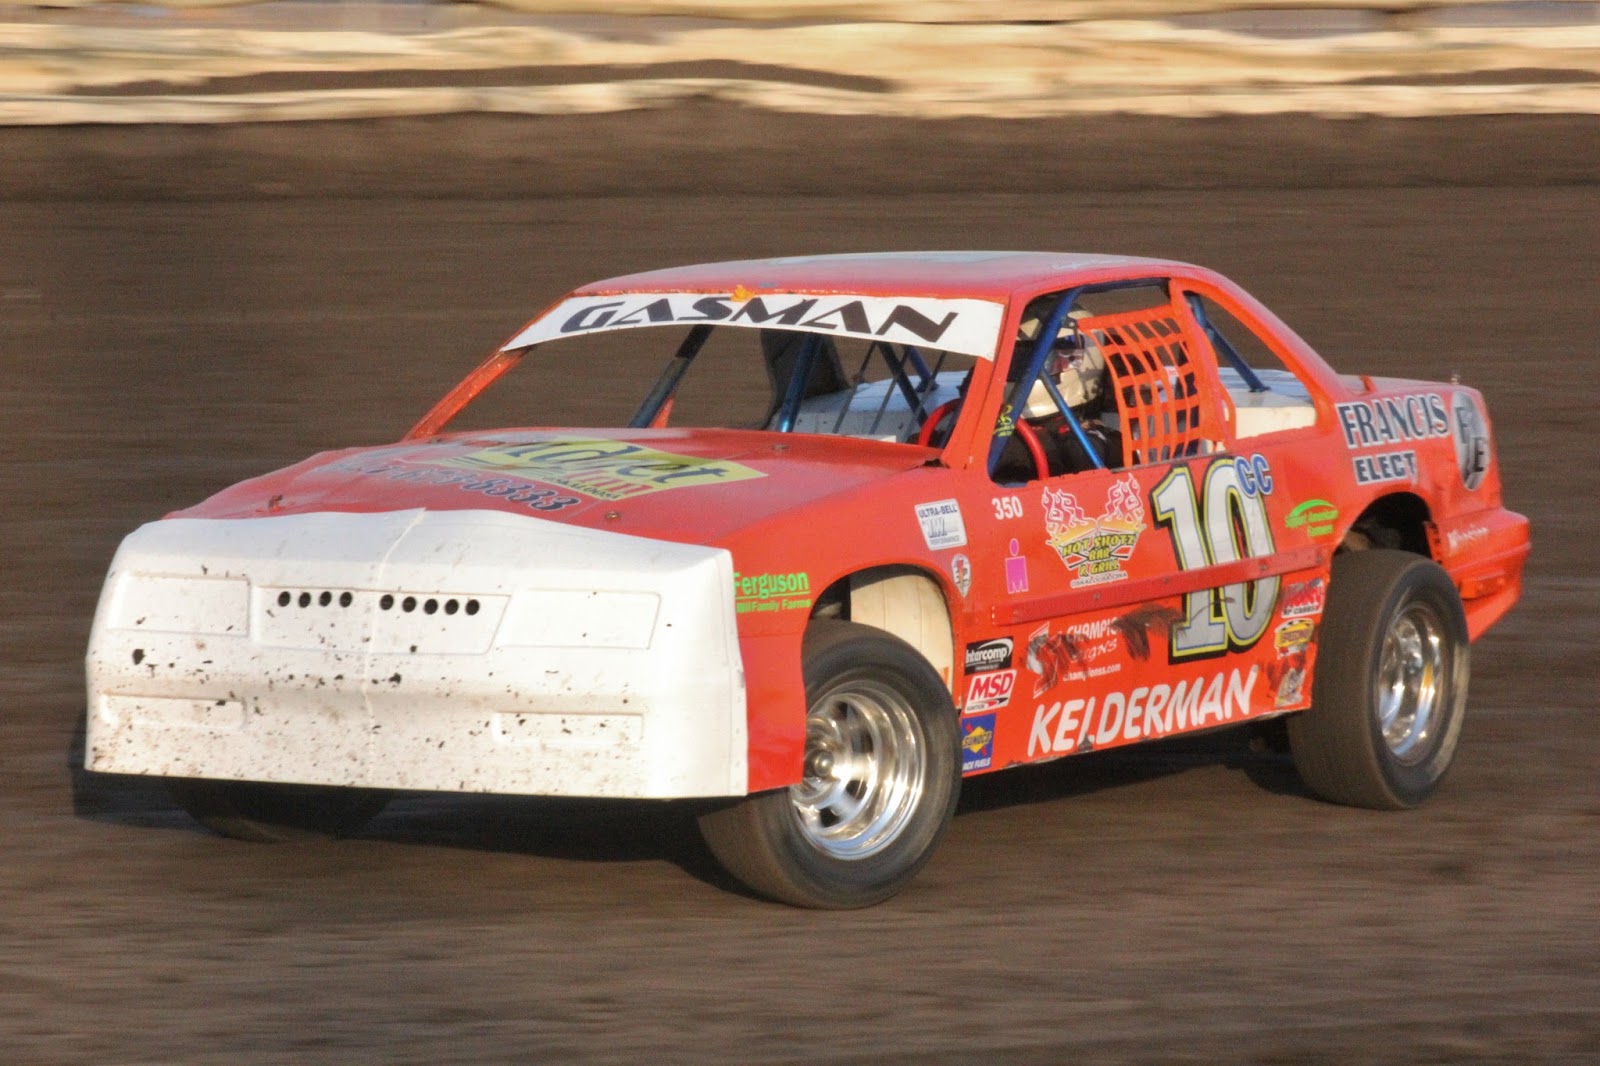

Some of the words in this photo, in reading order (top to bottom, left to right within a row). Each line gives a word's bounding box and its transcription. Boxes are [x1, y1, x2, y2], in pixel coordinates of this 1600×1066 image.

[560, 296, 959, 343] GASMAN
[1337, 393, 1449, 448] FRANCIS
[1353, 450, 1418, 485] ELECT
[918, 504, 957, 519] ULTRA-BELL
[992, 496, 1023, 520] 350
[1062, 538, 1090, 558] HOT
[1093, 533, 1136, 549] SHOTZ
[1088, 548, 1111, 560] BAR
[1091, 558, 1119, 575] GRILL
[1151, 457, 1280, 663] 10
[733, 572, 809, 599] Ferguson
[966, 647, 1007, 663] Intercomp
[970, 672, 1013, 701] MSD
[1027, 668, 1257, 756] KELDERMAN
